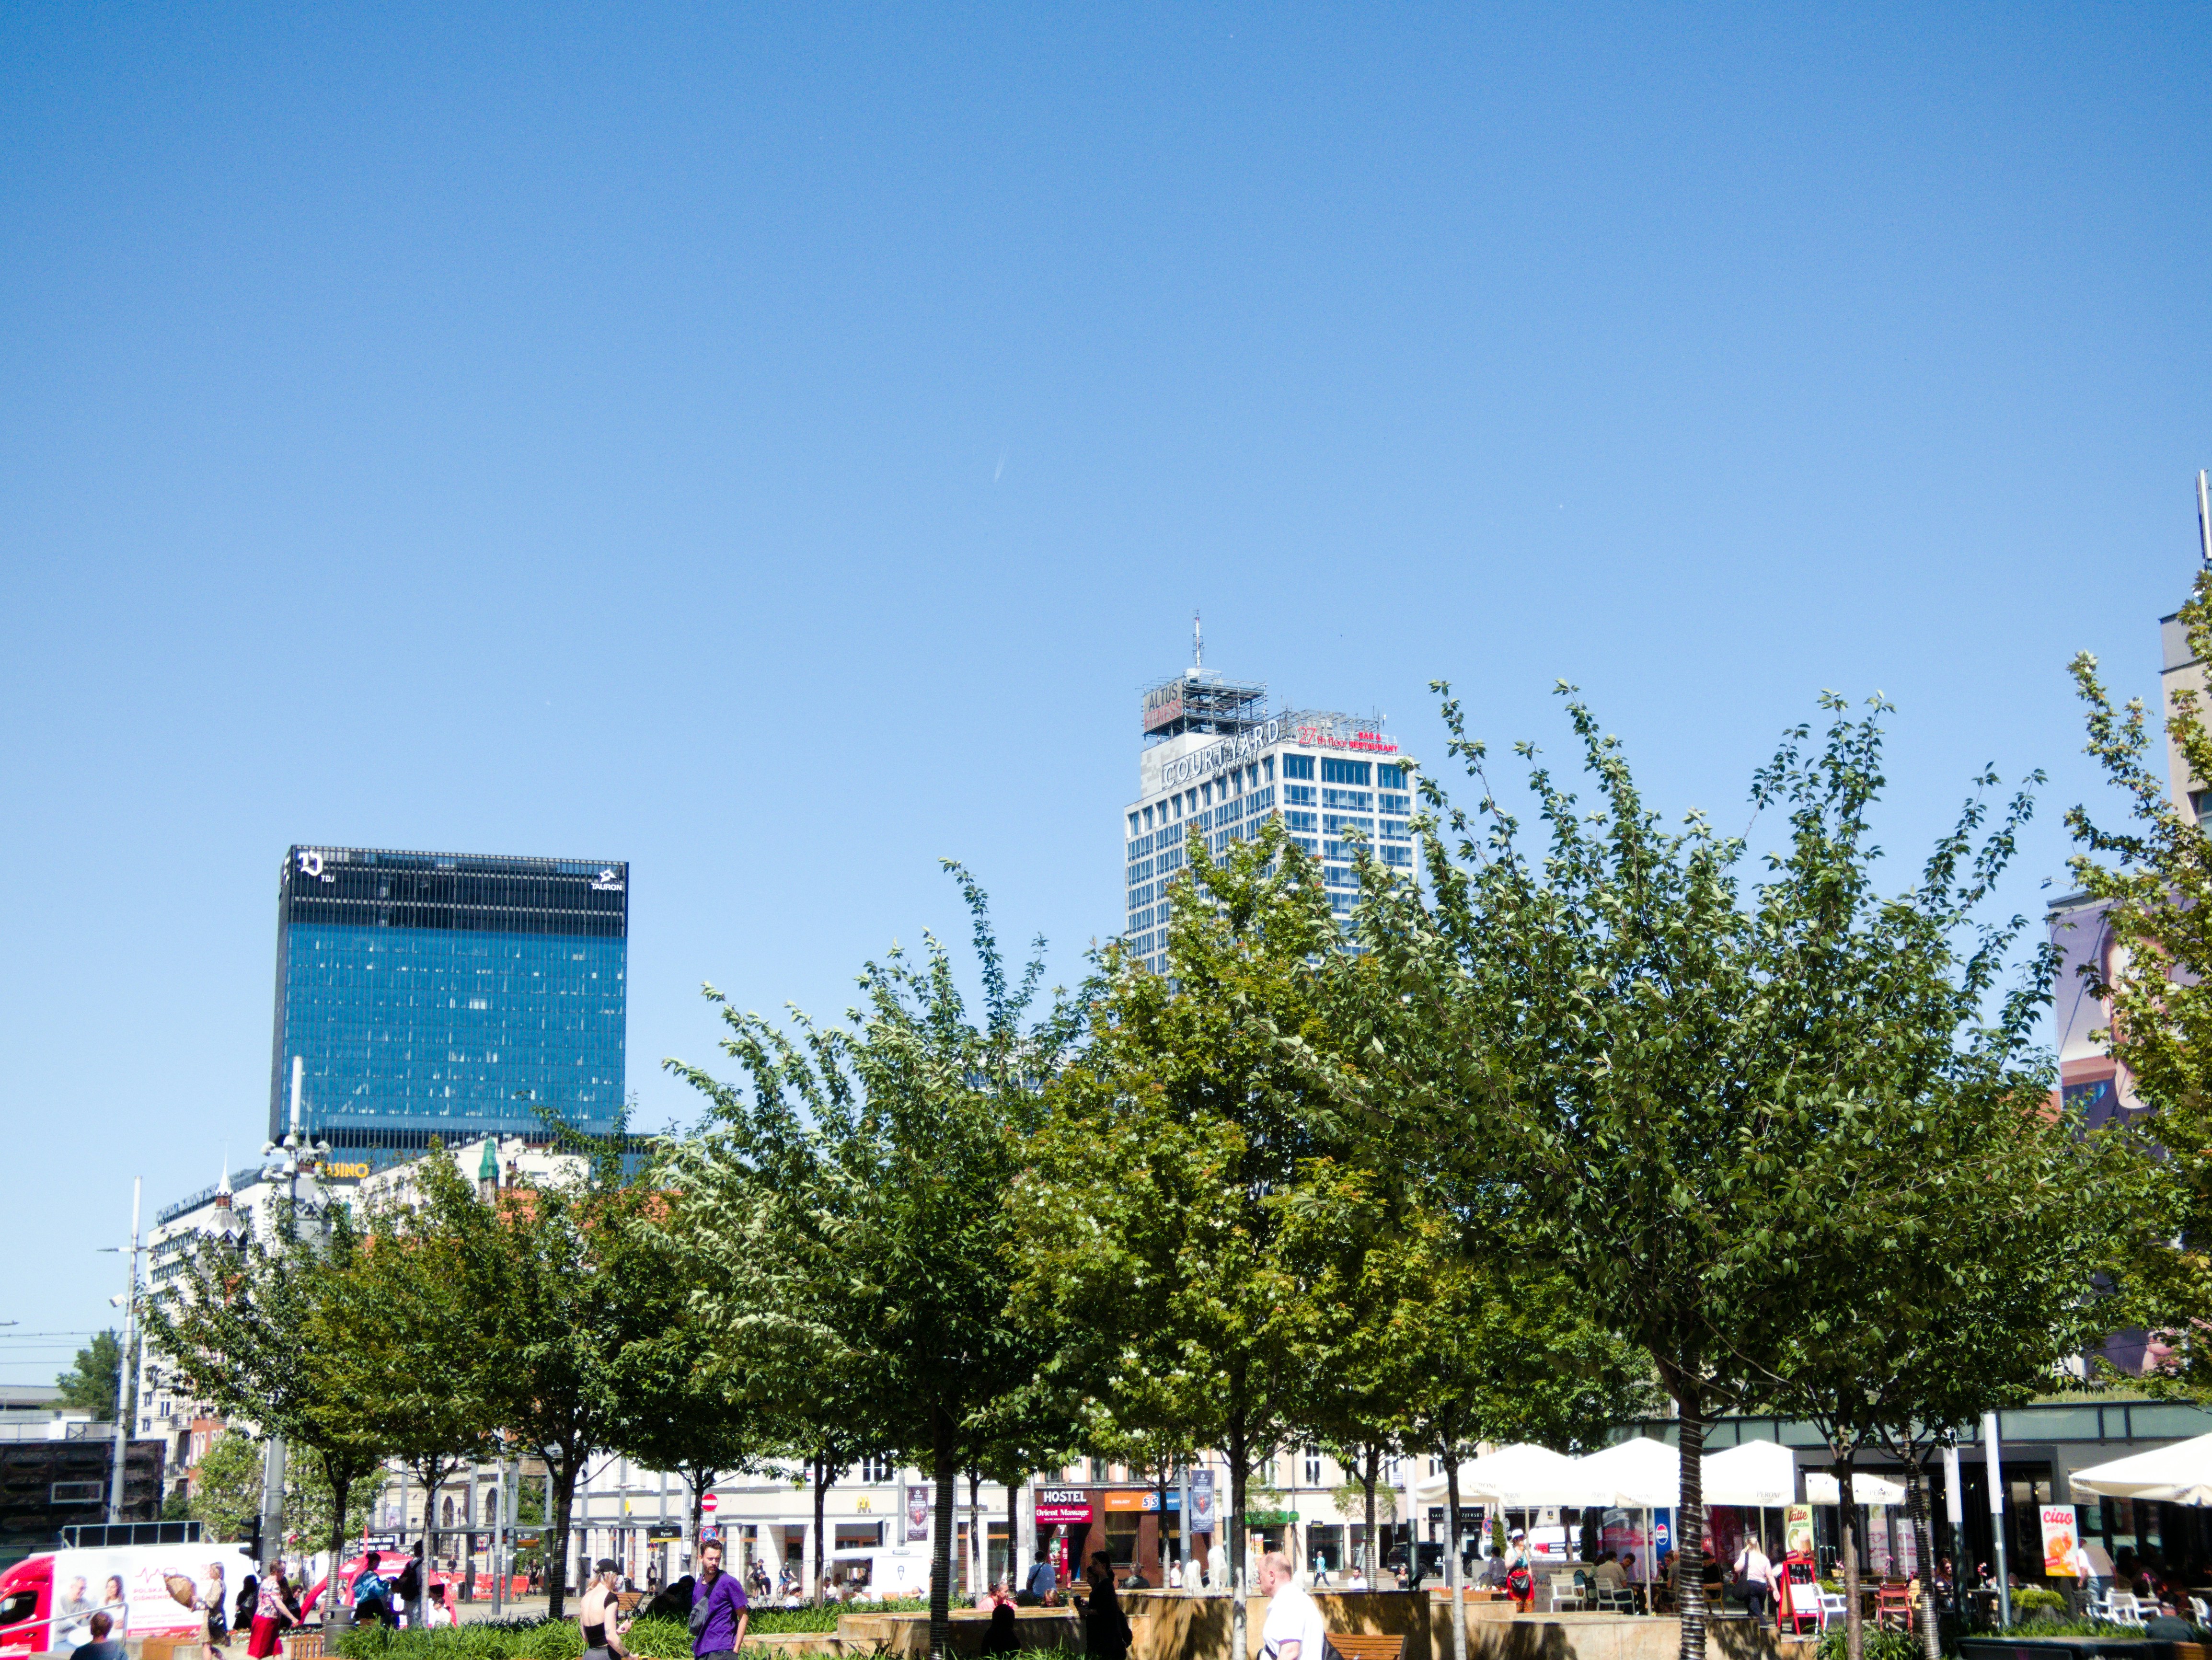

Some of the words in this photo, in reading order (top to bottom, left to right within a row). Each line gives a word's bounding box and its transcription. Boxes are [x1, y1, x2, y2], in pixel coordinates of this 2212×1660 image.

[1149, 682, 1177, 712] ALTUS
[1145, 698, 1182, 731] FITNESS
[1298, 726, 1317, 744] 27
[1349, 740, 1398, 752] RESTAURANT
[1359, 731, 1374, 740] BAR
[1376, 733, 1382, 741] &
[1164, 719, 1279, 787] COURTYARD
[1211, 766, 1221, 776] BY
[1222, 749, 1258, 772] MARRIOTT
[1044, 1491, 1087, 1502] HOSTEL
[1142, 1495, 1159, 1508] STS
[1060, 1509, 1089, 1517] Massage
[1788, 1509, 1808, 1523] latte
[2043, 1507, 2073, 1525] ciao
[1060, 1527, 1066, 1535] 7
